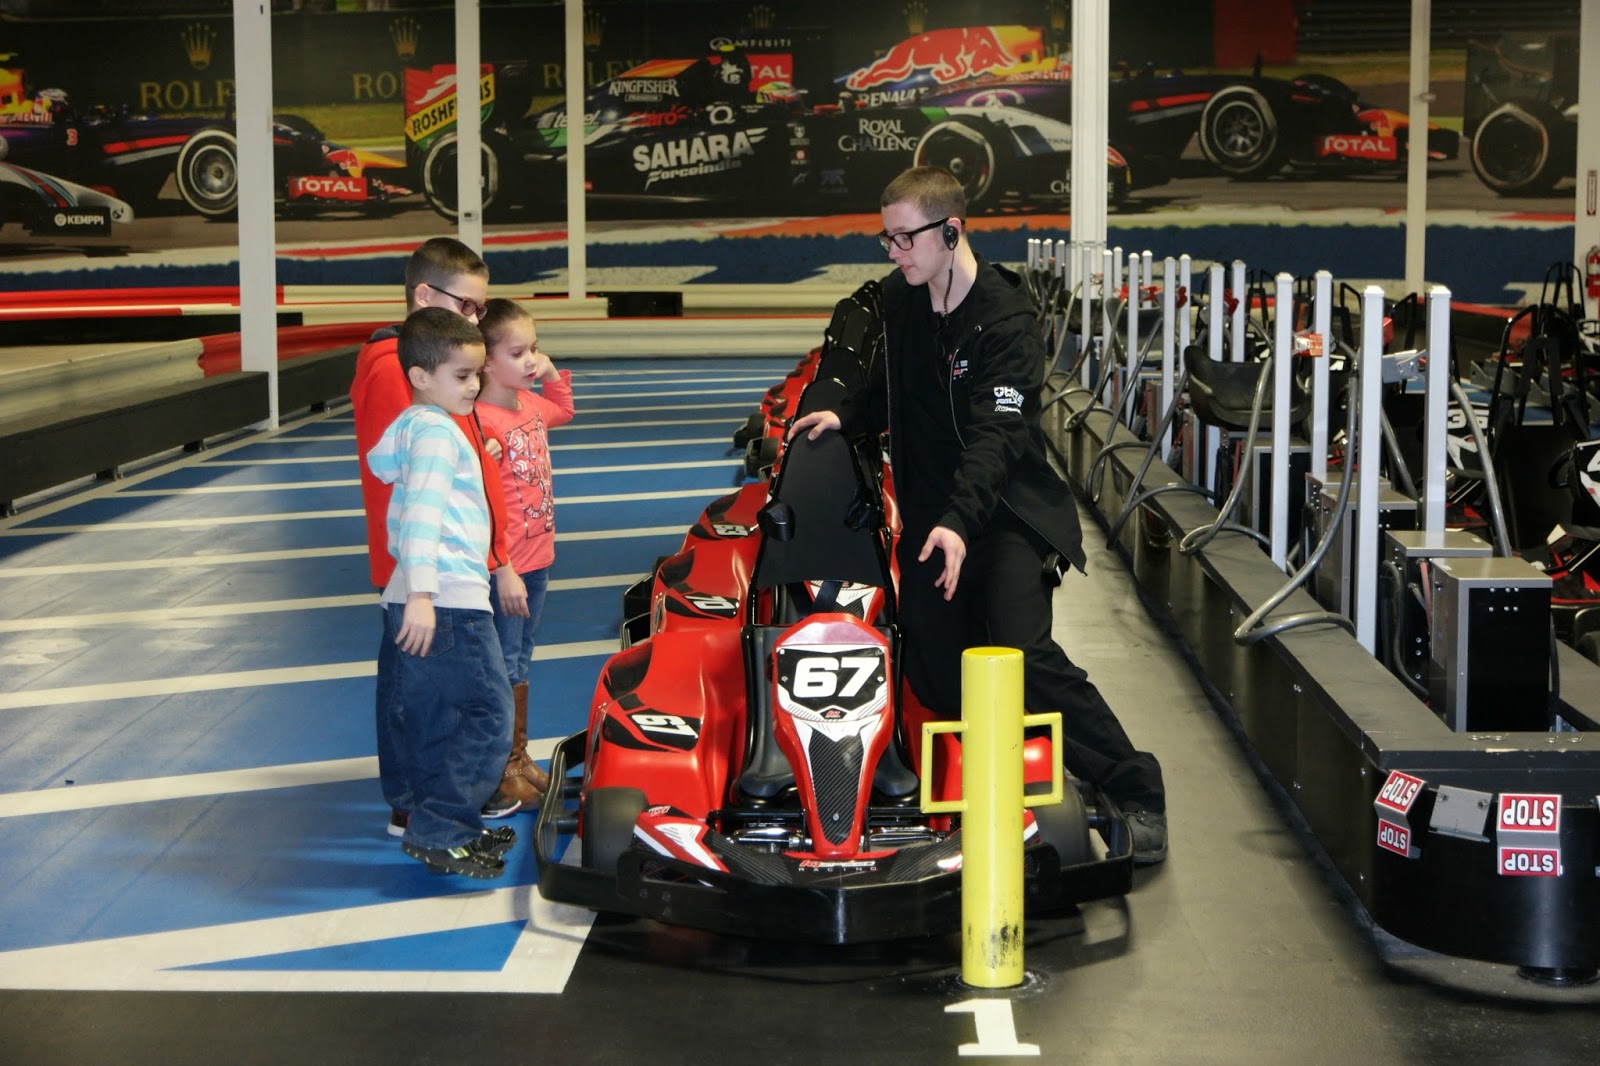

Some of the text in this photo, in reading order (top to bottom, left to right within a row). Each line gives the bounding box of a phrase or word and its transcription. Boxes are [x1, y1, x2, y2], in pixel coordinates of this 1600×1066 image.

[749, 65, 791, 79] TAL
[608, 79, 680, 97] KINGFISHER
[66, 128, 78, 146] 3
[1324, 135, 1391, 152] TOTAL
[632, 131, 756, 172] SAHARA
[297, 177, 362, 193] TOTAL
[67, 214, 105, 226] KEMPPI
[793, 656, 880, 699] 67
[1380, 775, 1419, 808] STOP
[1502, 799, 1555, 827] STOP
[1380, 826, 1407, 850] STOP
[1504, 853, 1554, 873] STOP
[943, 998, 1041, 1056] 1
